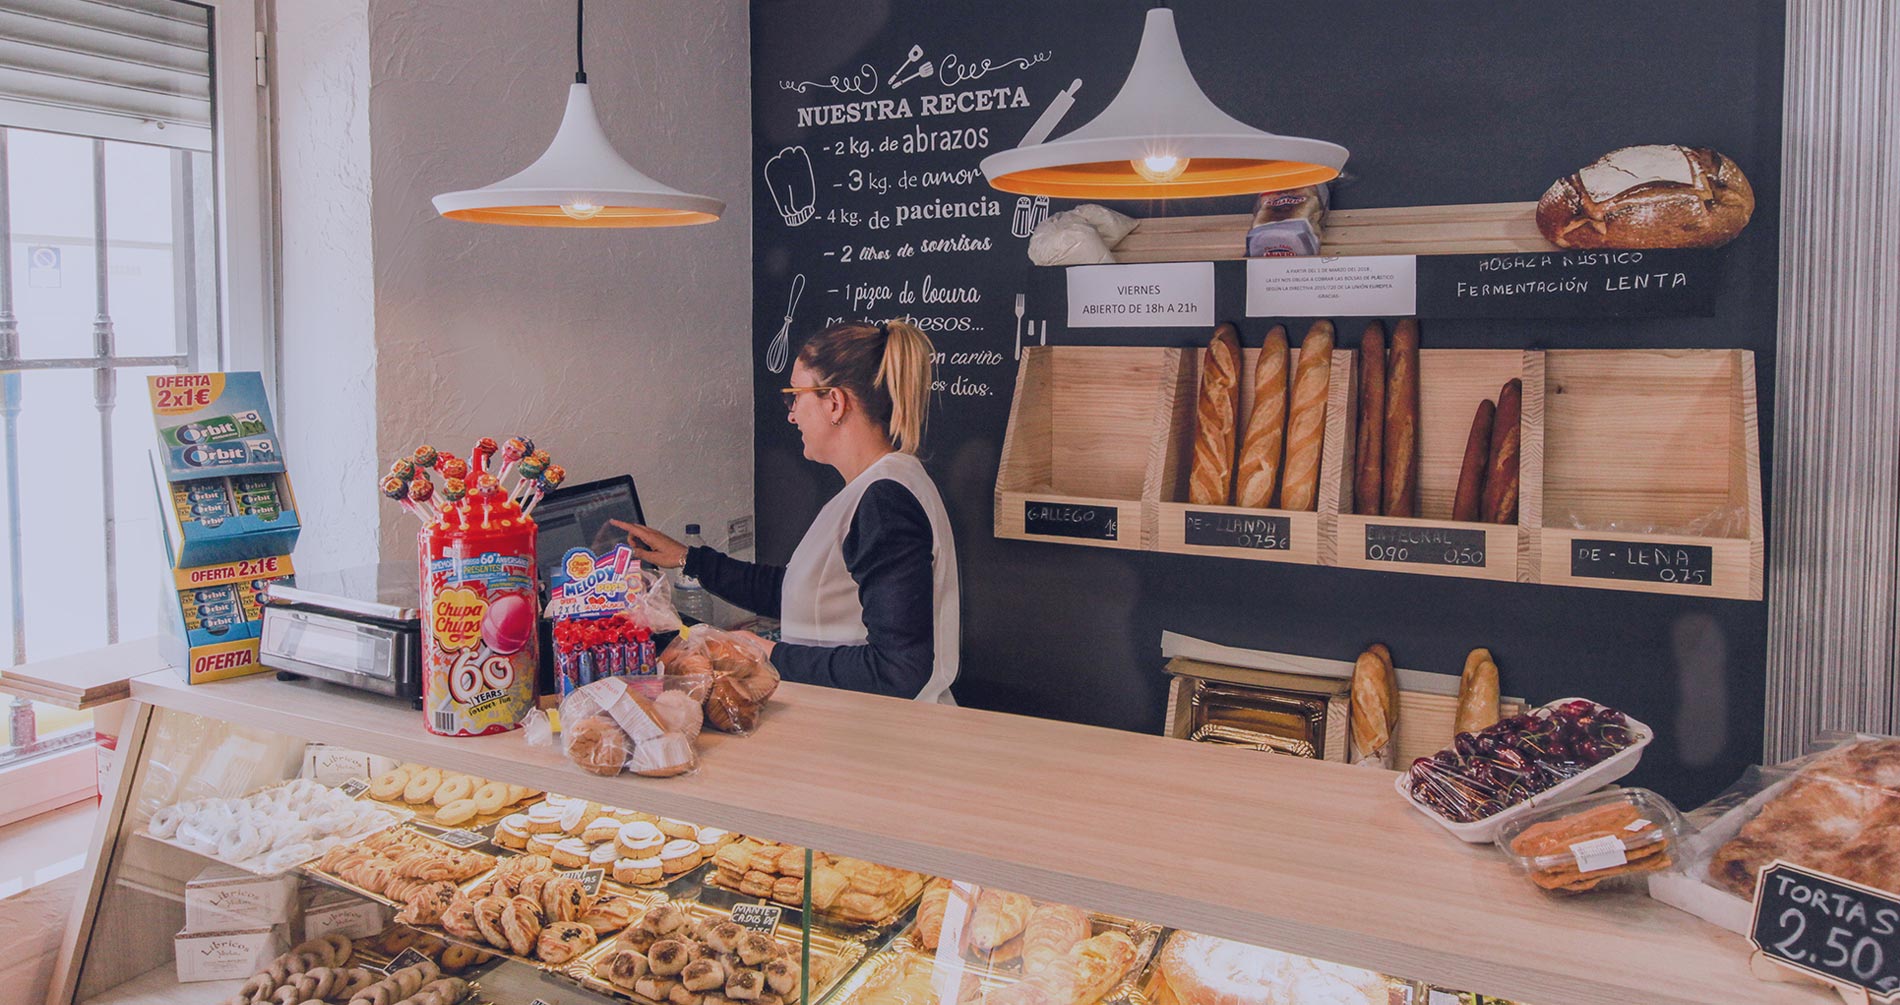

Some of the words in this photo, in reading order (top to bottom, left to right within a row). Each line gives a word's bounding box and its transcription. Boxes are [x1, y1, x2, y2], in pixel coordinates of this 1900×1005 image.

[797, 98, 912, 127] NUESTRA
[920, 86, 1030, 116] RECETA
[835, 141, 845, 156] 2
[849, 136, 875, 157] kg.
[879, 135, 899, 153] de
[902, 124, 990, 154] abrazos
[847, 169, 864, 192] 3
[868, 171, 893, 195] kg.
[897, 167, 918, 189] de
[921, 167, 982, 188] amor
[827, 209, 836, 224] 4
[840, 206, 863, 227] kg.
[868, 211, 890, 230] de
[896, 196, 1001, 227] paciencia
[840, 245, 852, 263] 2
[858, 245, 891, 262] litros
[896, 242, 915, 258] de
[920, 233, 993, 253] sonrisas
[1117, 285, 1160, 296] VIERNES
[1605, 272, 1687, 291] LENTA
[845, 284, 851, 300] 1
[853, 281, 893, 312] pizca
[899, 281, 916, 304] de
[922, 274, 981, 304] locura
[1083, 303, 1127, 315] ABIERTO
[1129, 303, 1142, 314] DE
[1145, 303, 1165, 314] 18h
[1166, 303, 1176, 314] A
[1177, 302, 1198, 314] 21h
[950, 350, 1004, 365] cariño
[156, 374, 211, 388] OFERTA
[951, 375, 994, 397] días.
[157, 388, 210, 408] 2x1€
[176, 423, 235, 445] Orbit
[183, 446, 244, 467] Orbit
[1027, 507, 1096, 523] GALLEGO
[191, 567, 236, 583] OFERTA
[239, 557, 278, 577] 2x1€
[564, 566, 615, 597] MELODY
[436, 602, 483, 621] Chupa
[435, 617, 481, 641] Chups
[195, 650, 252, 673] OFERTA
[450, 650, 515, 703] 60
[474, 690, 503, 703] YEARS
[1776, 874, 1899, 934] TORTAS
[201, 941, 249, 956] Libricos
[1773, 907, 1883, 979] 2.50
